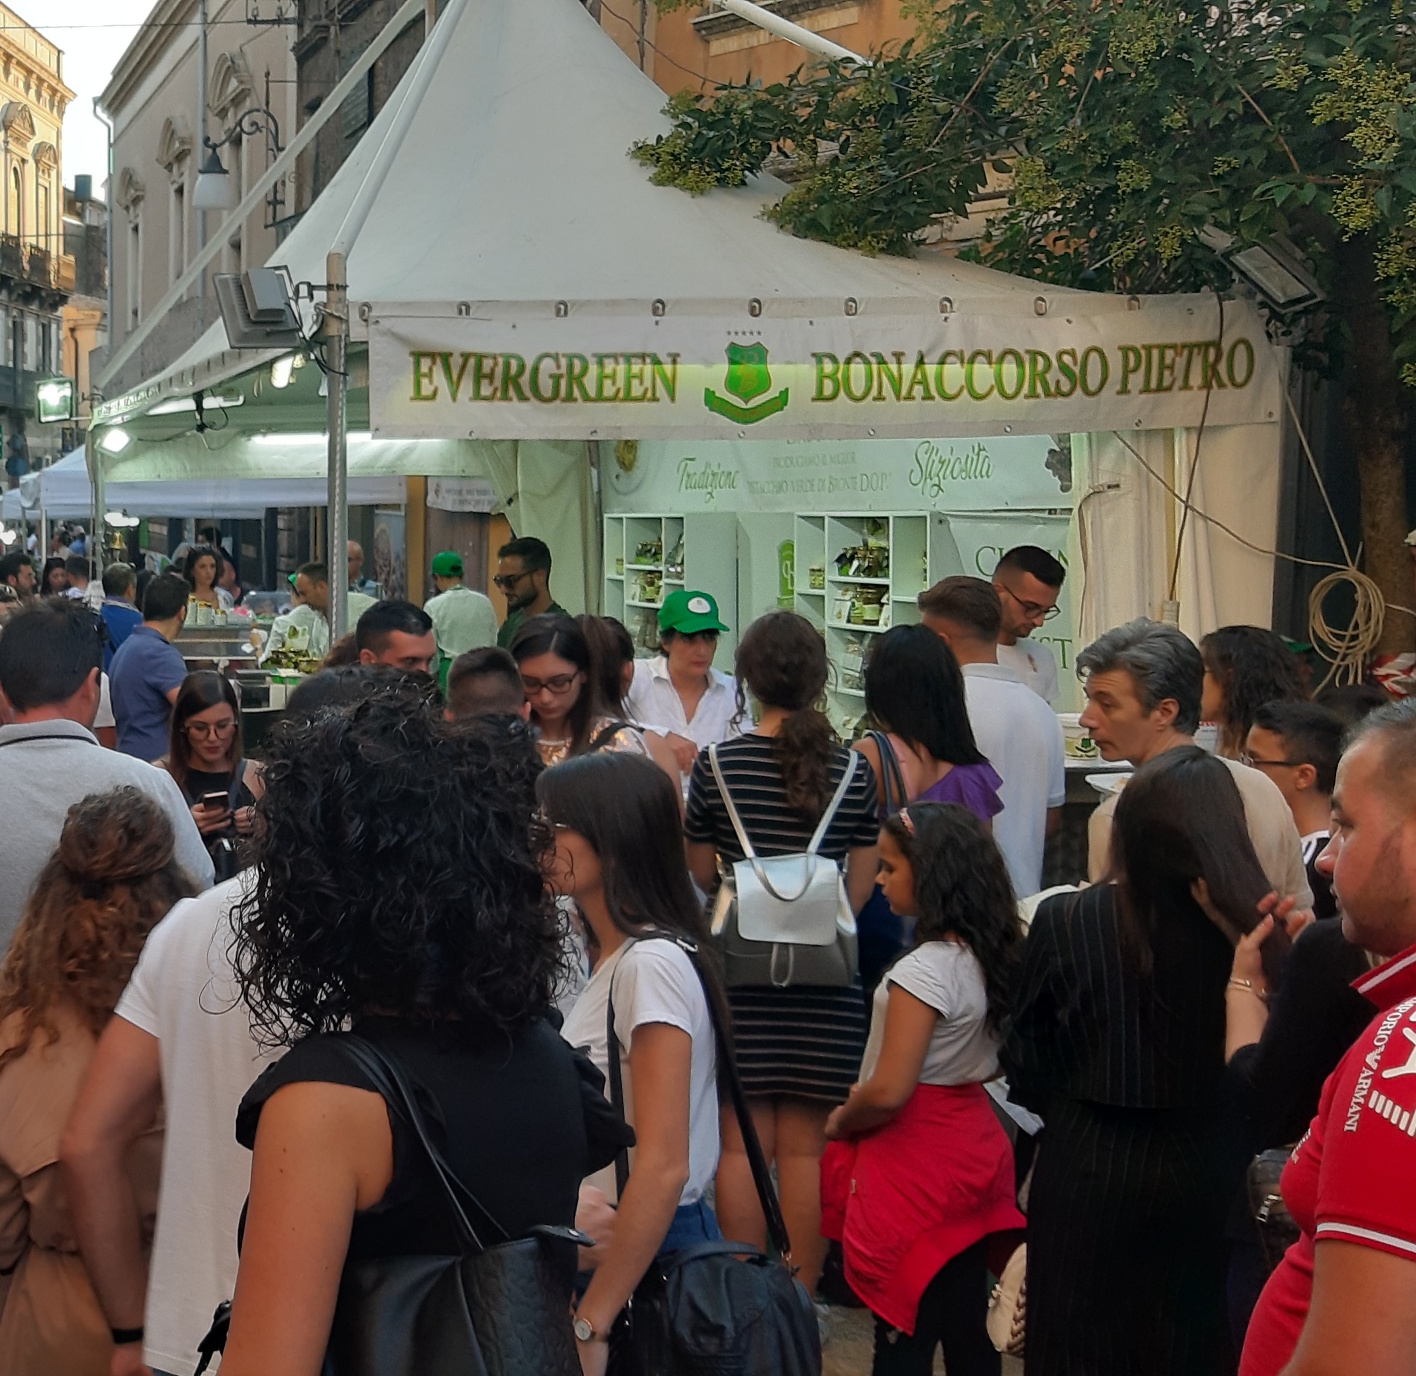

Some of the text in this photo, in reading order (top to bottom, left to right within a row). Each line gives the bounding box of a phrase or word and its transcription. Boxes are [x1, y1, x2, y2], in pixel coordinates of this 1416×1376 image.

[409, 350, 681, 403] EVERGREEN
[810, 345, 1110, 402] BONACCORSO
[1116, 337, 1255, 396] PIETRO
[676, 457, 740, 503] Tradizione
[1344, 1066, 1374, 1133] ARMANI
